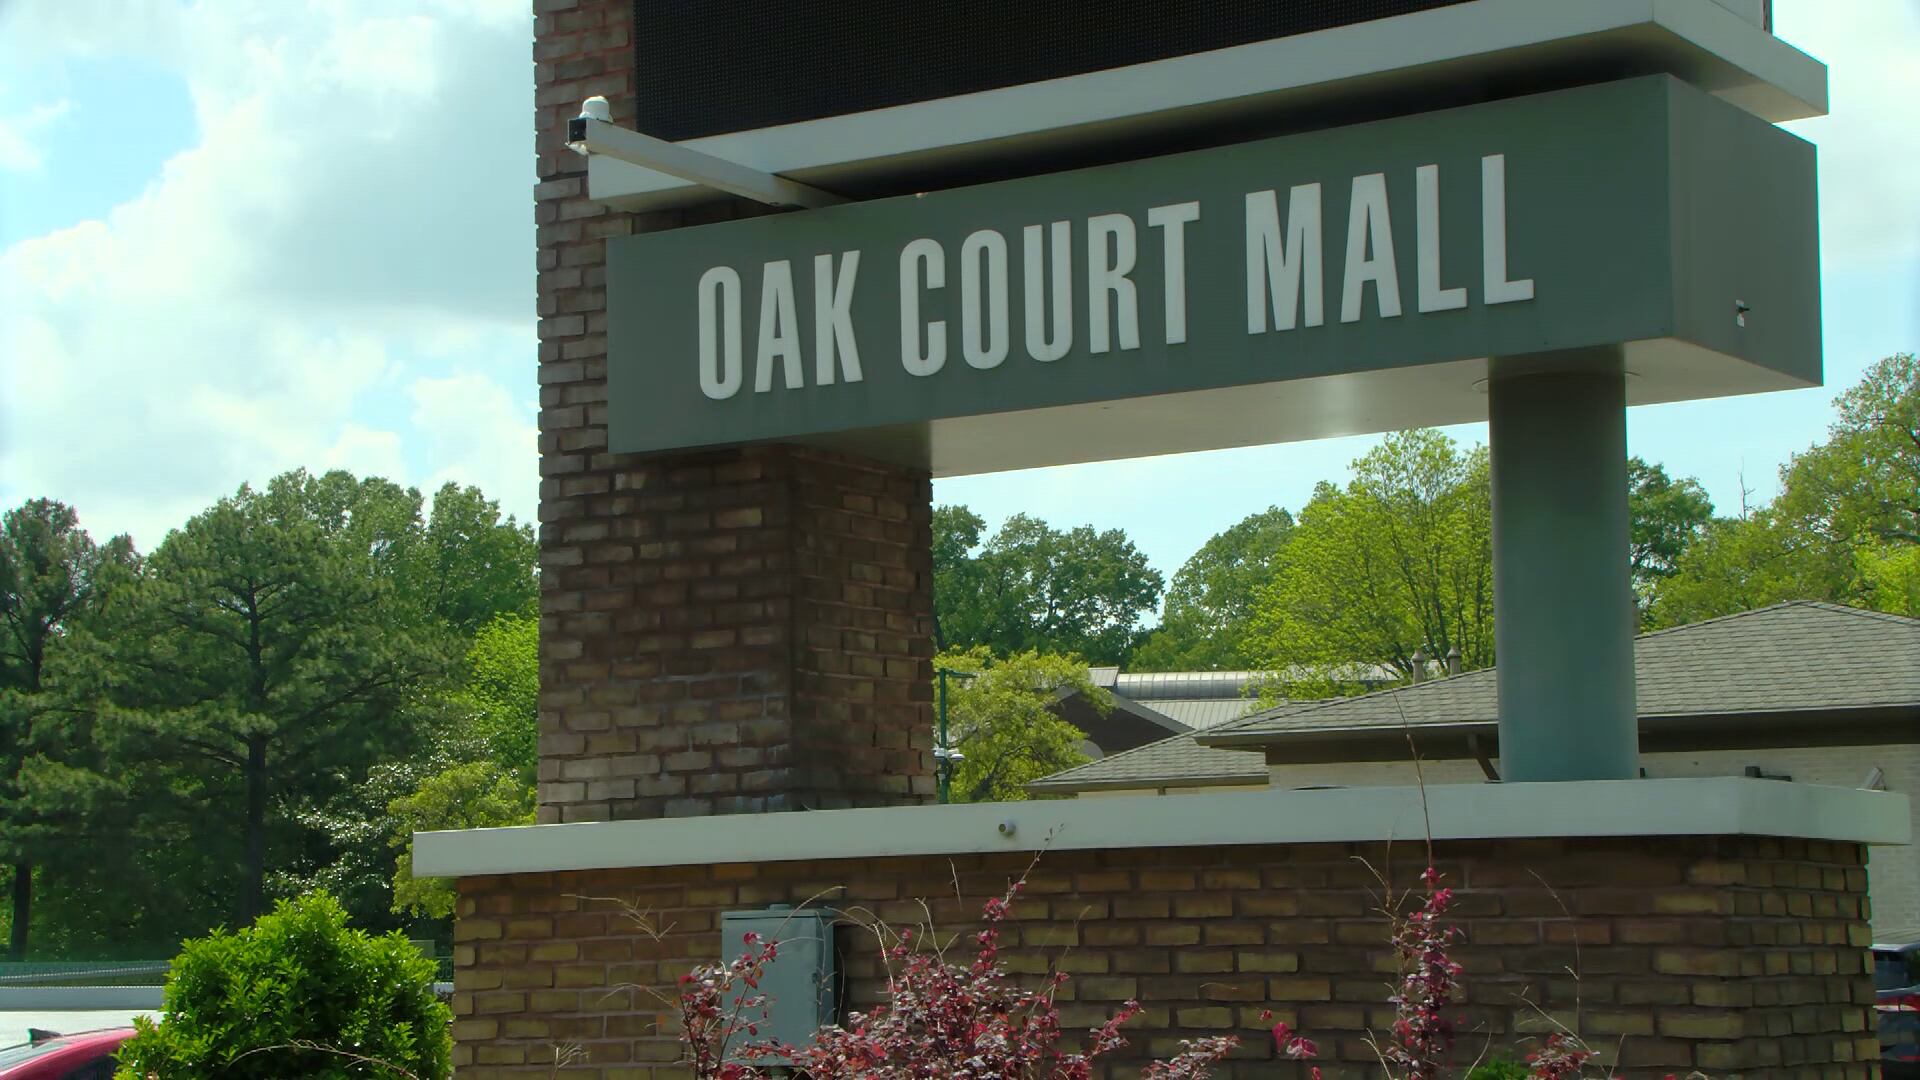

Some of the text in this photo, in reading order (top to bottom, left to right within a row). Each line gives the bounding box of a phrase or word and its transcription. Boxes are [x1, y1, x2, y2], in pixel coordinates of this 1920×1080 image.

[698, 153, 1535, 400] OAK COURT MALL
